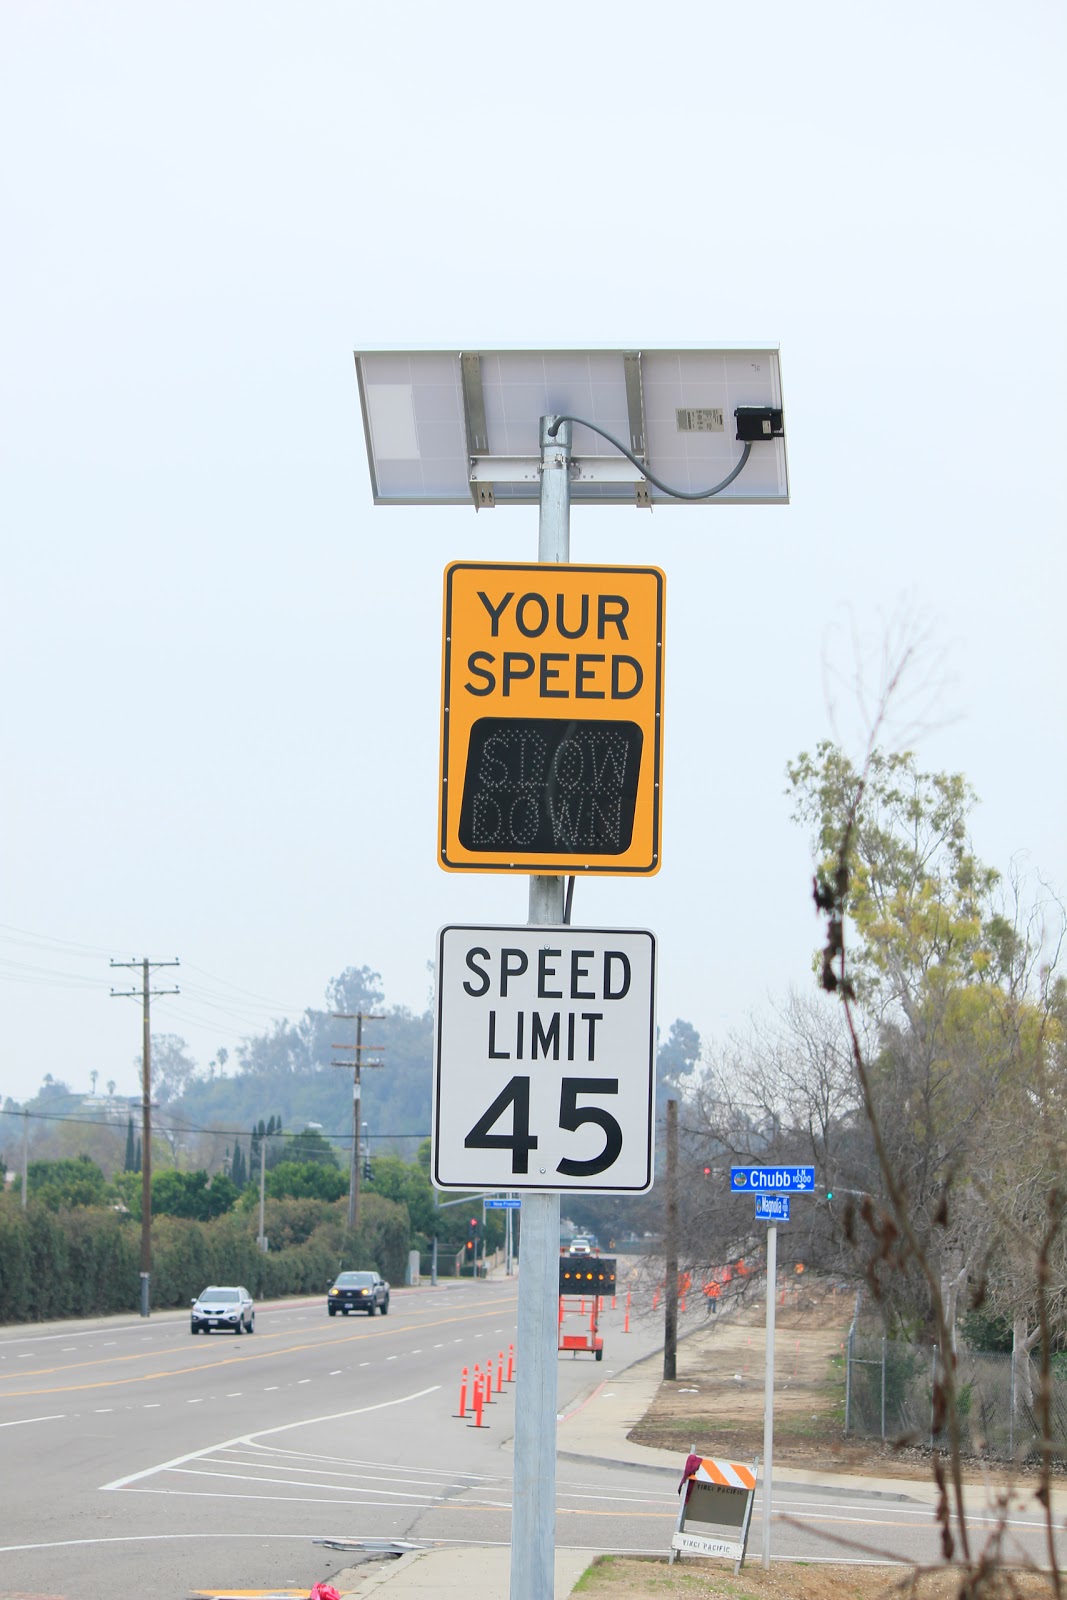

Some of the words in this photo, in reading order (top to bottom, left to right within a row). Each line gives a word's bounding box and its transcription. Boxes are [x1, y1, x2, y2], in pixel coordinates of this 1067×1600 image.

[476, 592, 630, 640] YOUR
[464, 651, 643, 699] SPEED
[479, 737, 629, 790] SLOW
[473, 793, 622, 846] DOWN
[463, 947, 631, 1000] SPEED
[488, 1011, 603, 1061] LIMIT
[464, 1075, 623, 1177] 45
[750, 1170, 791, 1187] Chubb
[792, 1175, 811, 1183] 10300
[761, 1196, 782, 1218] Magnolia
[717, 1486, 744, 1495] PACIFIC
[703, 1542, 730, 1553] PACIFIC
